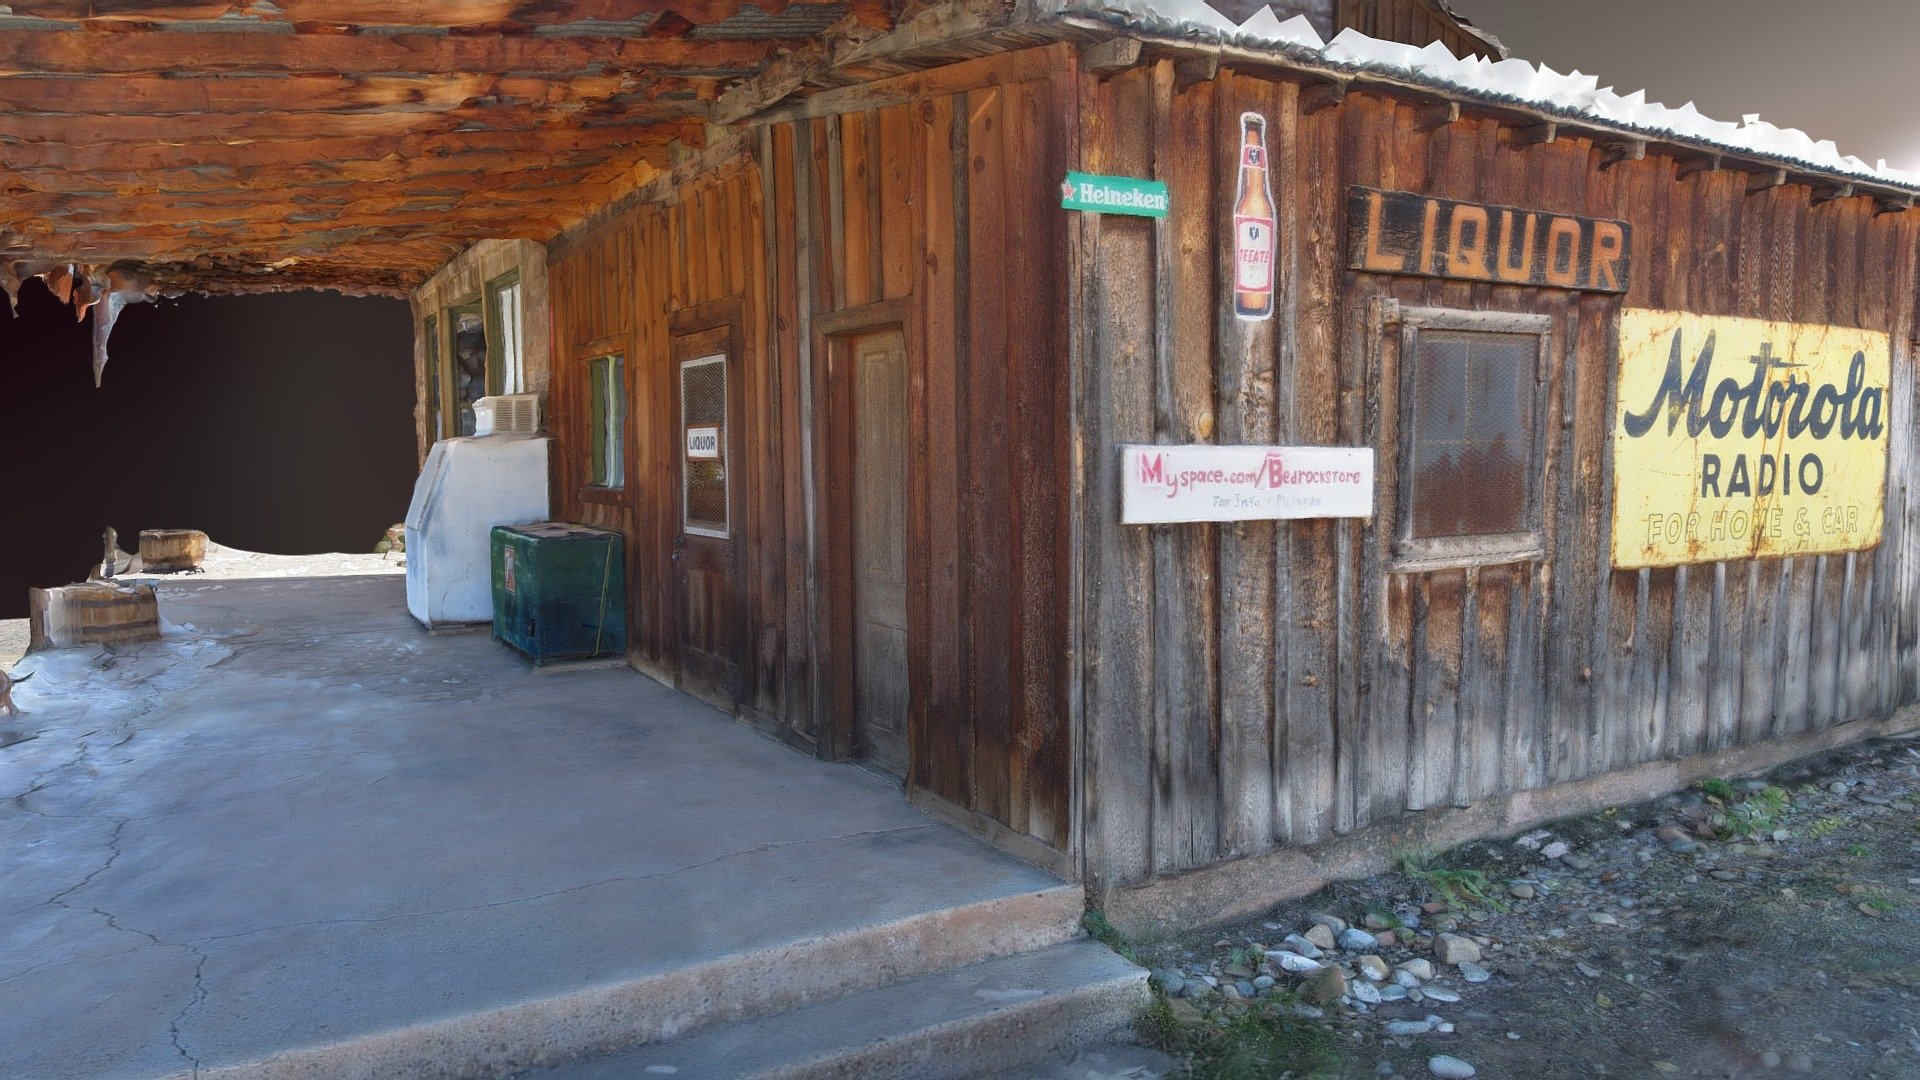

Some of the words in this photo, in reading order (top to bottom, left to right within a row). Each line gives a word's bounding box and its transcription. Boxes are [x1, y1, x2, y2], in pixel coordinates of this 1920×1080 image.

[1080, 183, 1166, 210] Heineken
[1239, 249, 1270, 263] TECATE
[1365, 191, 1623, 290] LIQUOR
[1623, 327, 1884, 440] Motorola
[689, 435, 716, 450] LIQUOR
[1701, 453, 1824, 498] RADIO
[1647, 511, 1701, 544] FOR
[1793, 506, 1811, 536] &
[1822, 505, 1859, 535] CAR
